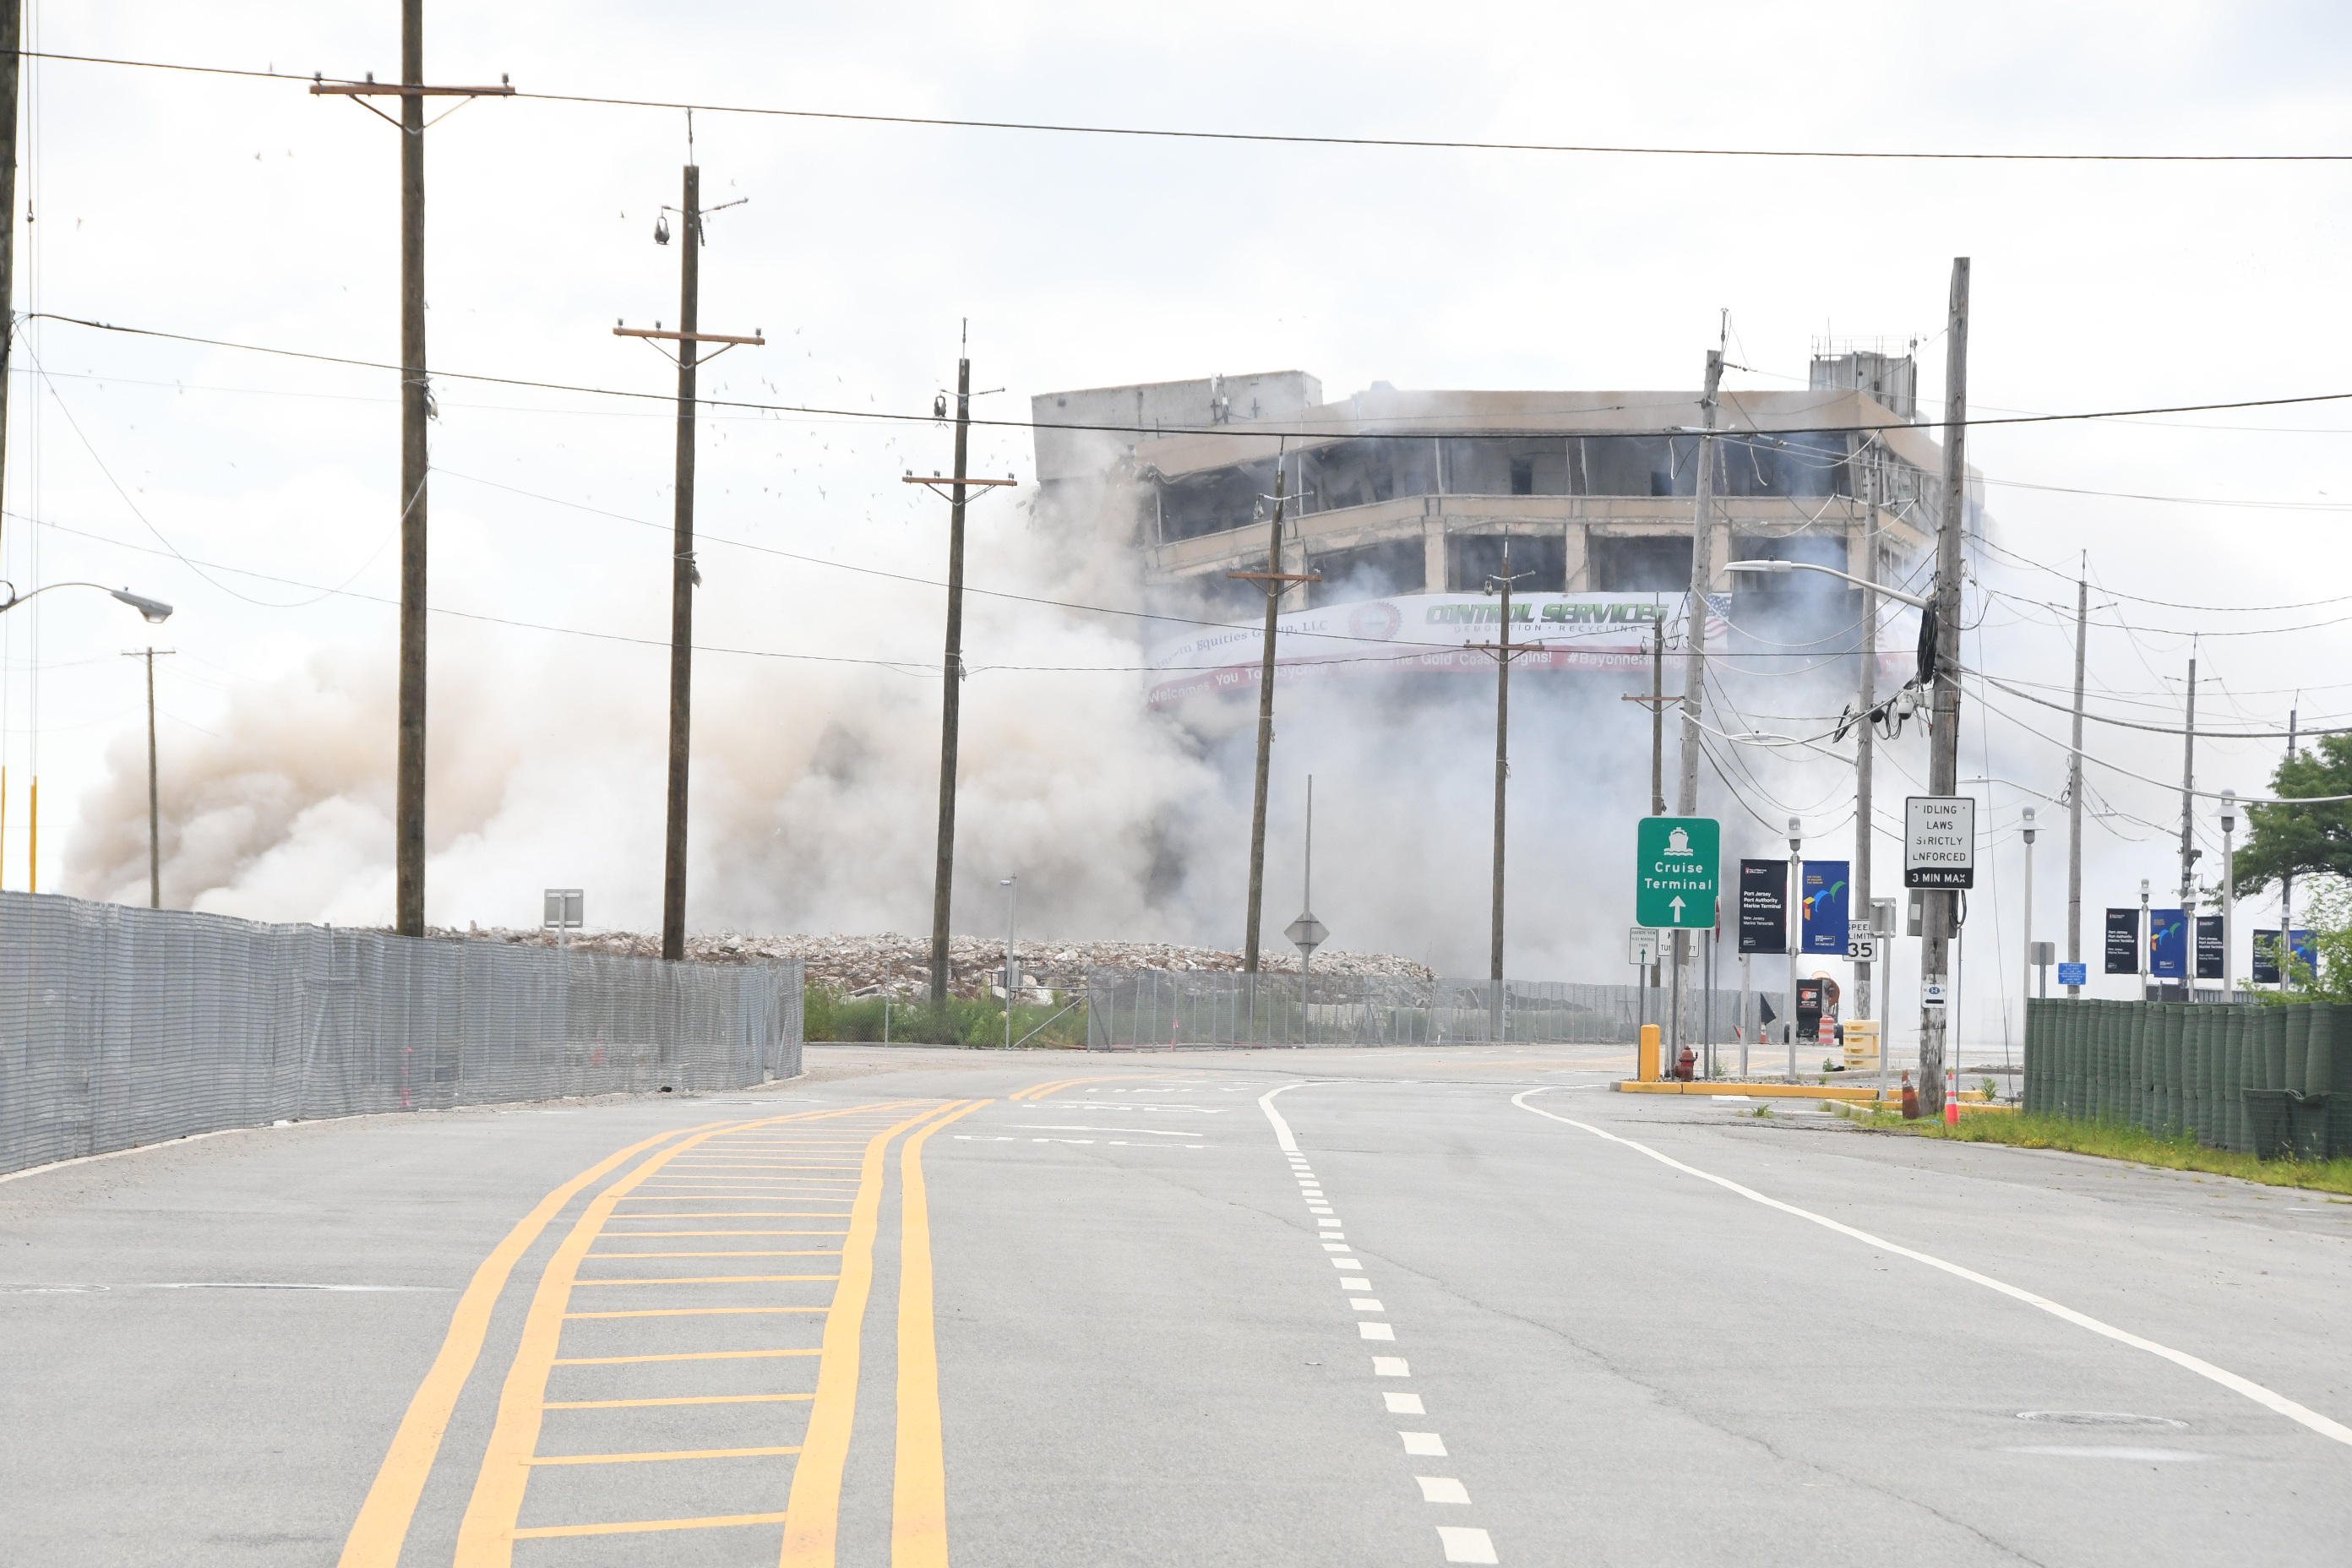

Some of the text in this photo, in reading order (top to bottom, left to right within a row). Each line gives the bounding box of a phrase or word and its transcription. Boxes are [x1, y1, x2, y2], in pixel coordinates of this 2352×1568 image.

[1425, 603, 1669, 623] CONTROL SERVICES
[1455, 624, 1637, 633] DEMOLTION RECYCLING
[1195, 632, 1248, 651] Equities
[1252, 623, 1298, 639] Gup,
[1302, 620, 1329, 632] LLC
[1216, 672, 1239, 687] You
[1244, 667, 1261, 681] To
[1421, 651, 1452, 666] Gold
[1459, 651, 1496, 666] Coast
[1507, 650, 1552, 667] egins!
[1567, 651, 1685, 670] #BayonneRing.
[1923, 805, 1957, 814] IDLING
[1926, 821, 1953, 830] LAWS
[1654, 861, 1703, 874] Cruise
[1644, 878, 1712, 890] Terminal
[1912, 873, 1966, 883] 3 MIN MAX
[1848, 942, 1873, 958] 35
